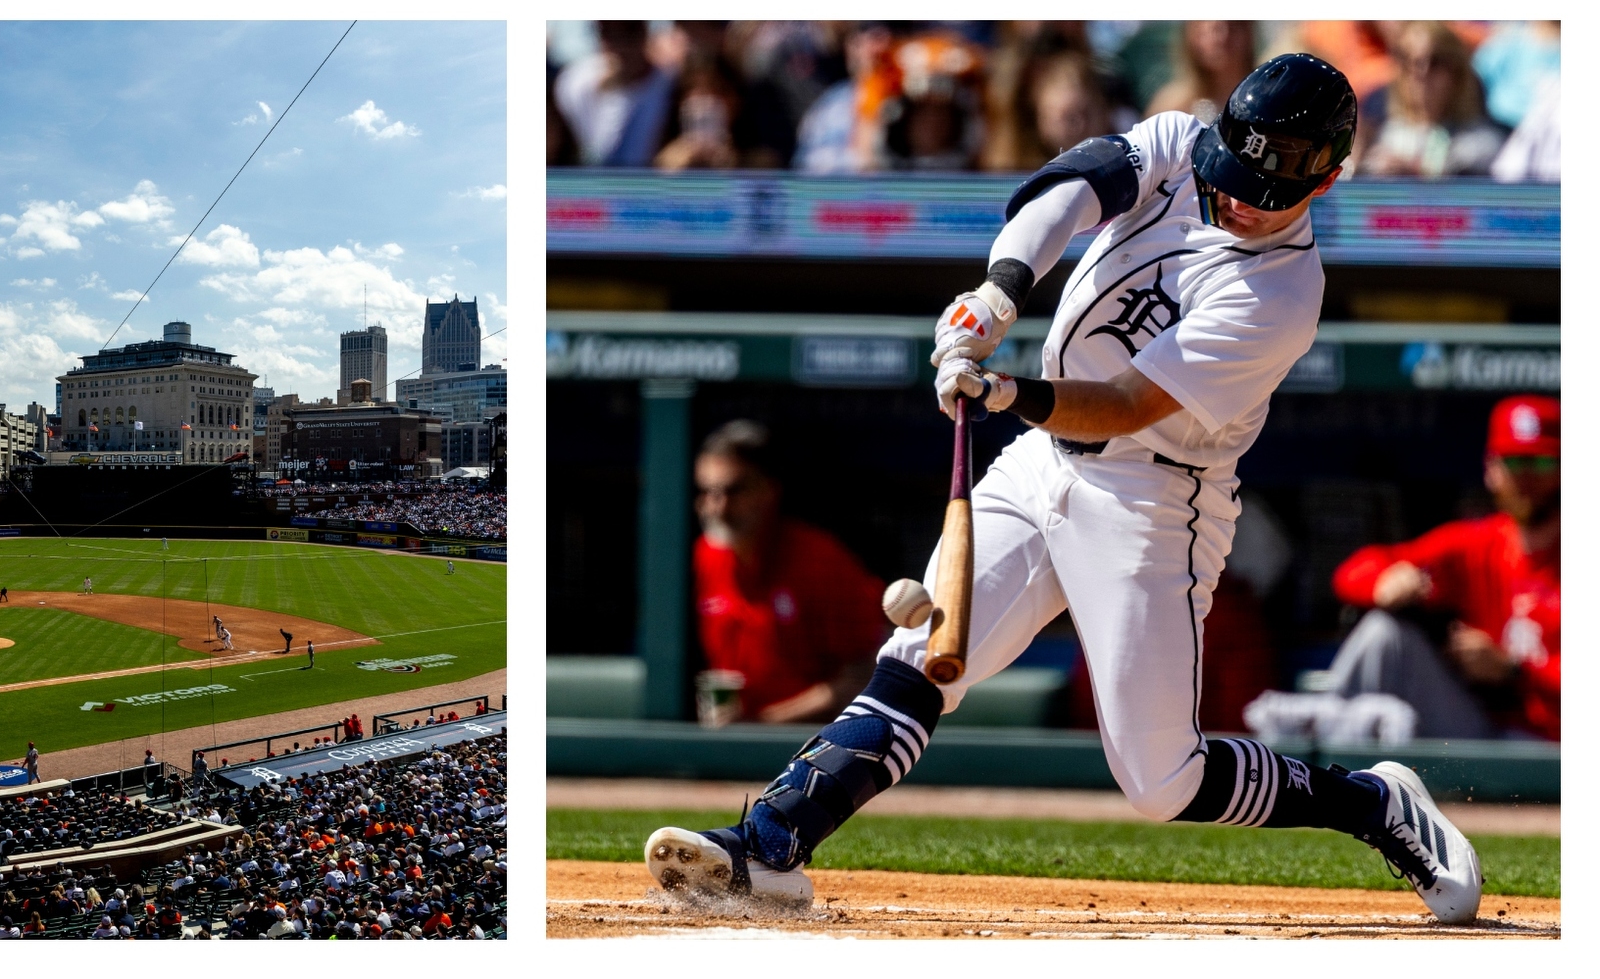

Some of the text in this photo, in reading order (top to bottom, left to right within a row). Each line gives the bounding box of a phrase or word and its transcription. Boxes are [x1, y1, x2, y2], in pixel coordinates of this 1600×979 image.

[1240, 125, 1268, 159] D
[103, 453, 183, 464] CHEVROLET
[278, 459, 310, 471] meijer
[431, 544, 467, 556] bet365
[113, 684, 229, 704] VICTORS
